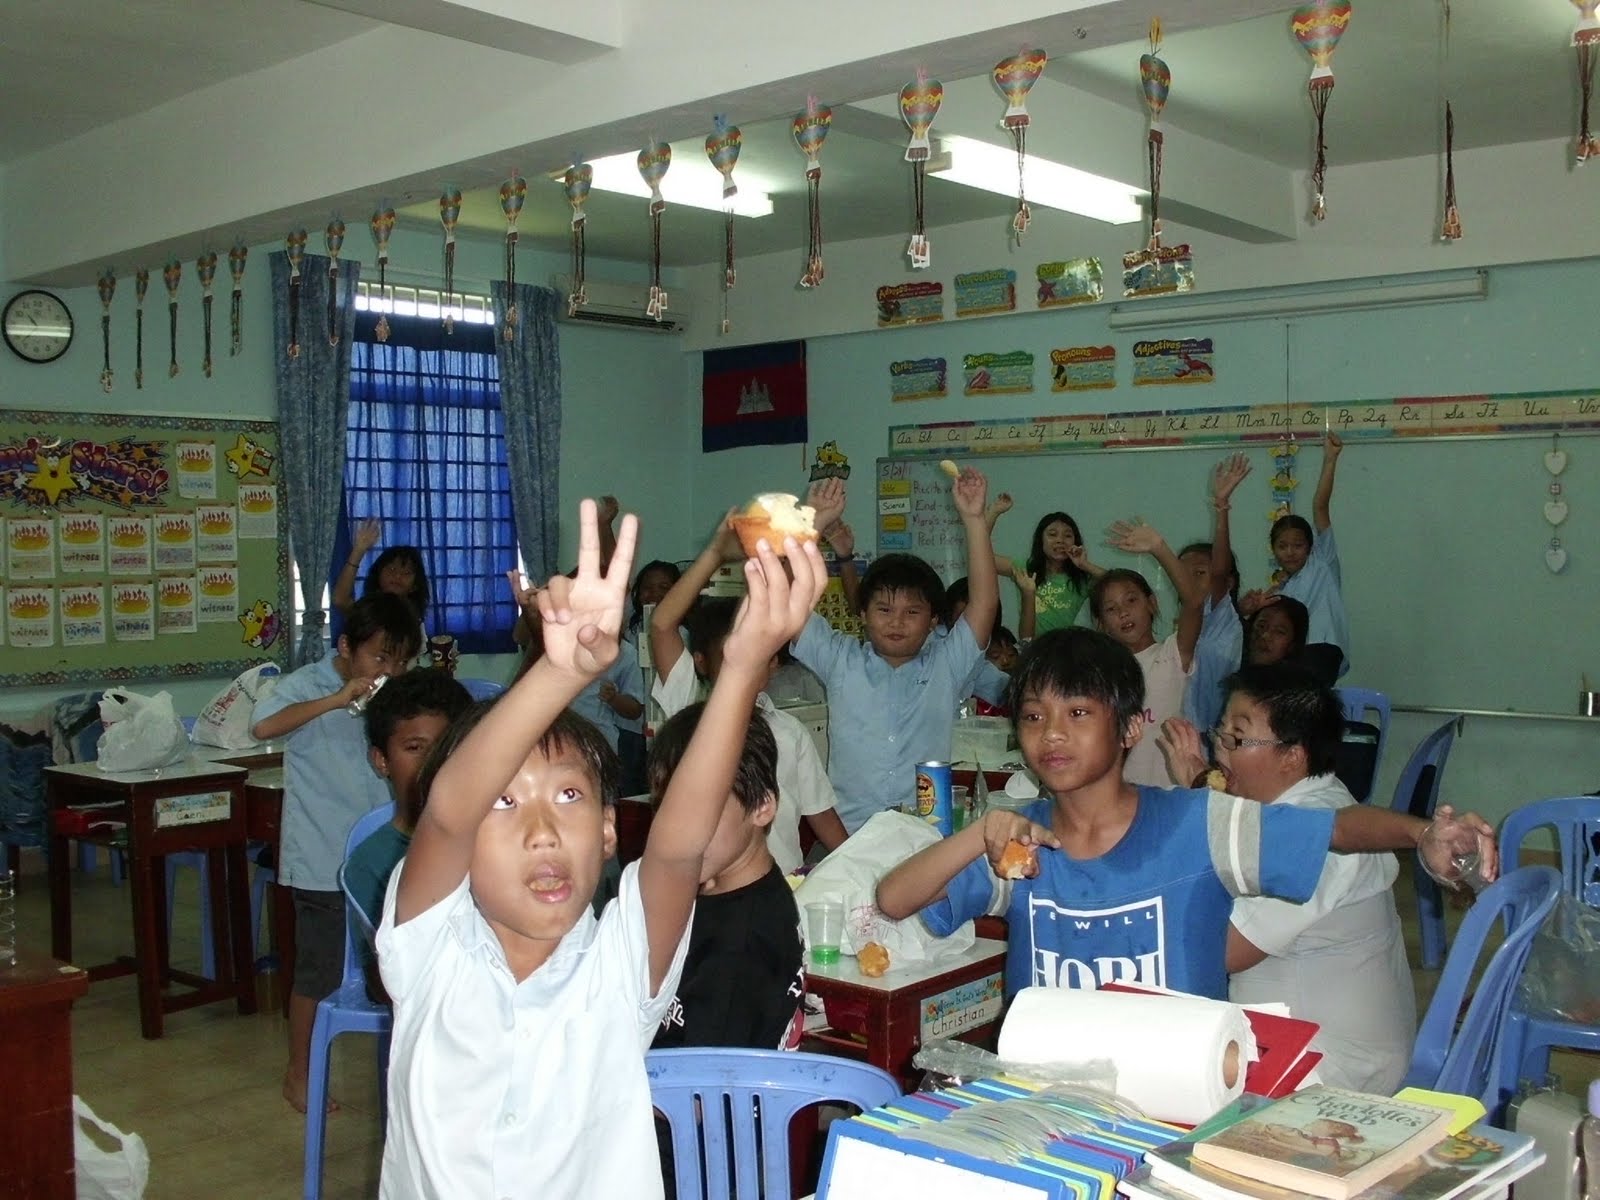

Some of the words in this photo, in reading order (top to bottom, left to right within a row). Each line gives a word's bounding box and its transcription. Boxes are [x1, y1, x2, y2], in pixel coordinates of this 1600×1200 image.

[1052, 348, 1092, 362] Pronouns
[1134, 340, 1181, 355] Adjectives
[1075, 911, 1154, 930] WILL
[932, 1008, 985, 1036] Christian
[1317, 1107, 1377, 1126] Web
